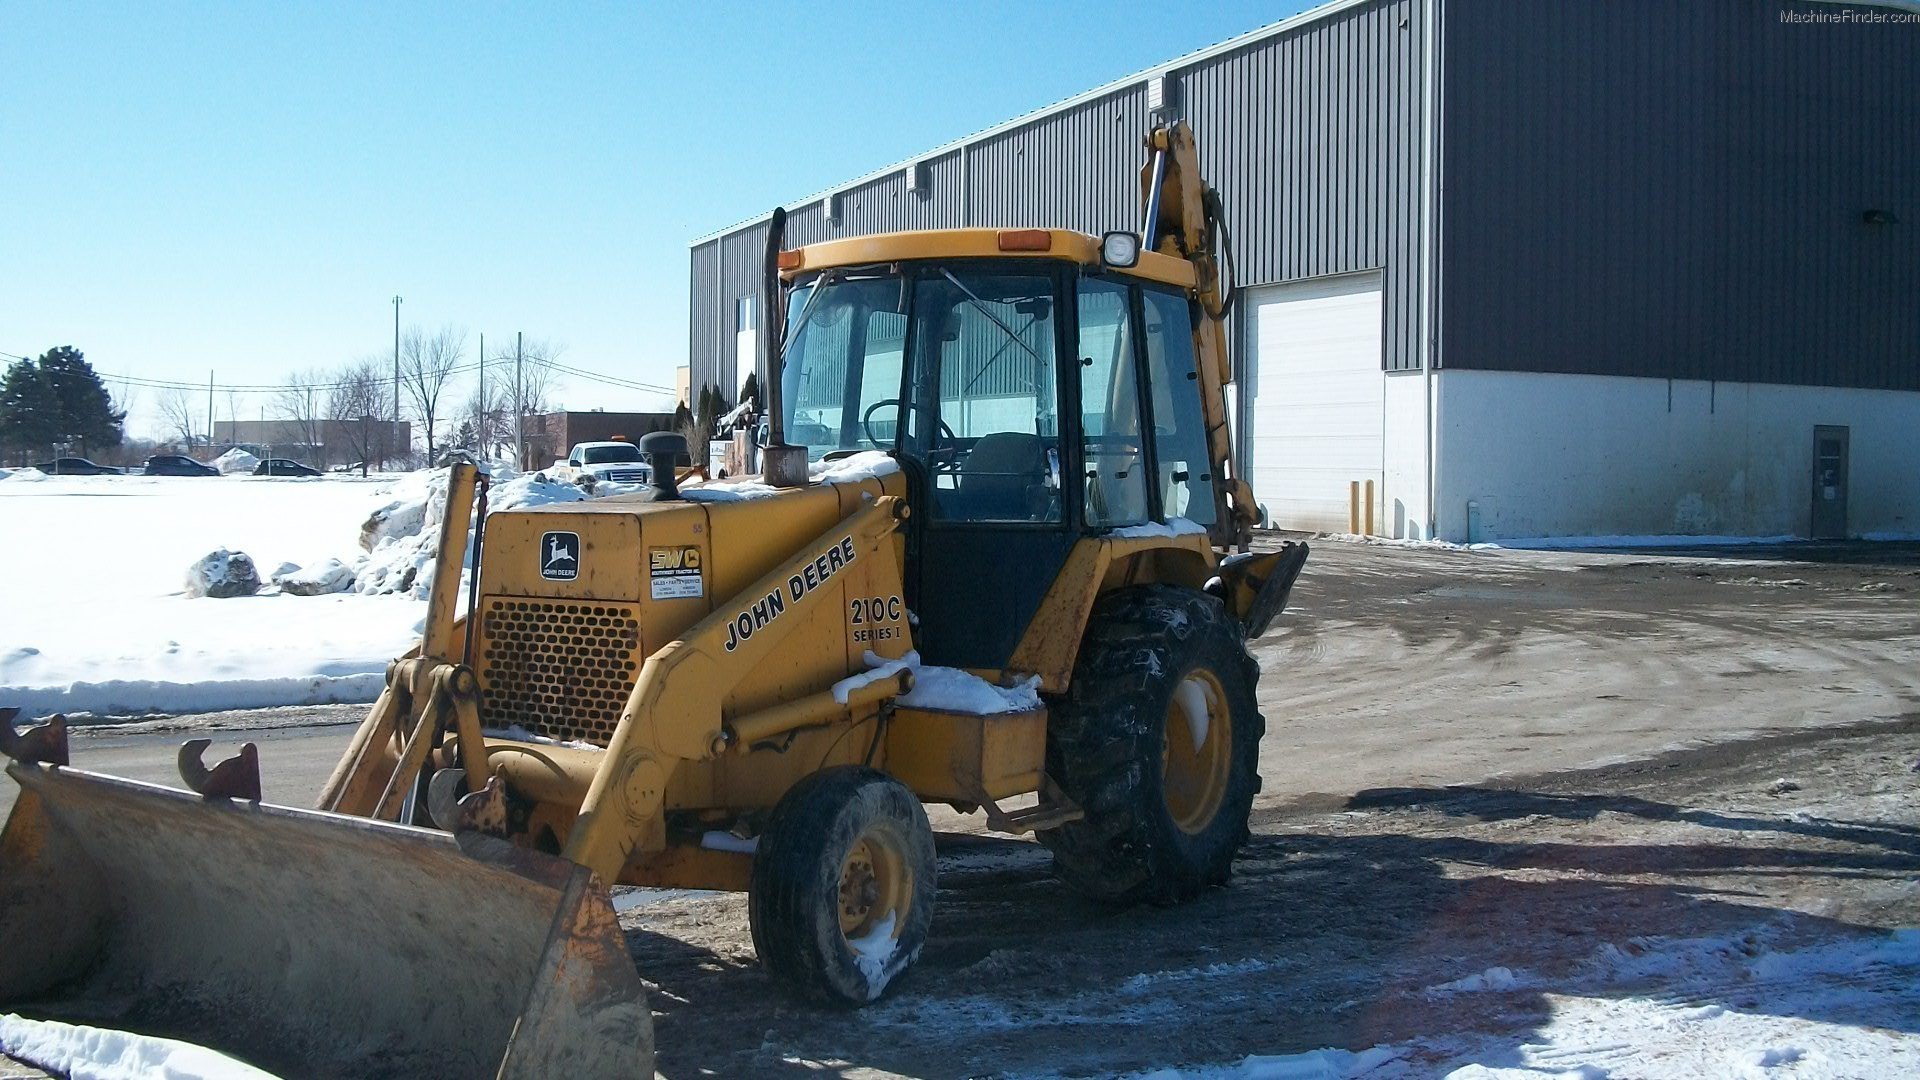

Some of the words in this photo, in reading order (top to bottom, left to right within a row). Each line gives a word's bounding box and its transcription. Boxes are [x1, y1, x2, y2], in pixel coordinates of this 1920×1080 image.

[725, 587, 785, 652] JOHN
[788, 535, 856, 604] DEERE
[851, 596, 900, 624] 210C
[853, 628, 892, 641] SERIES
